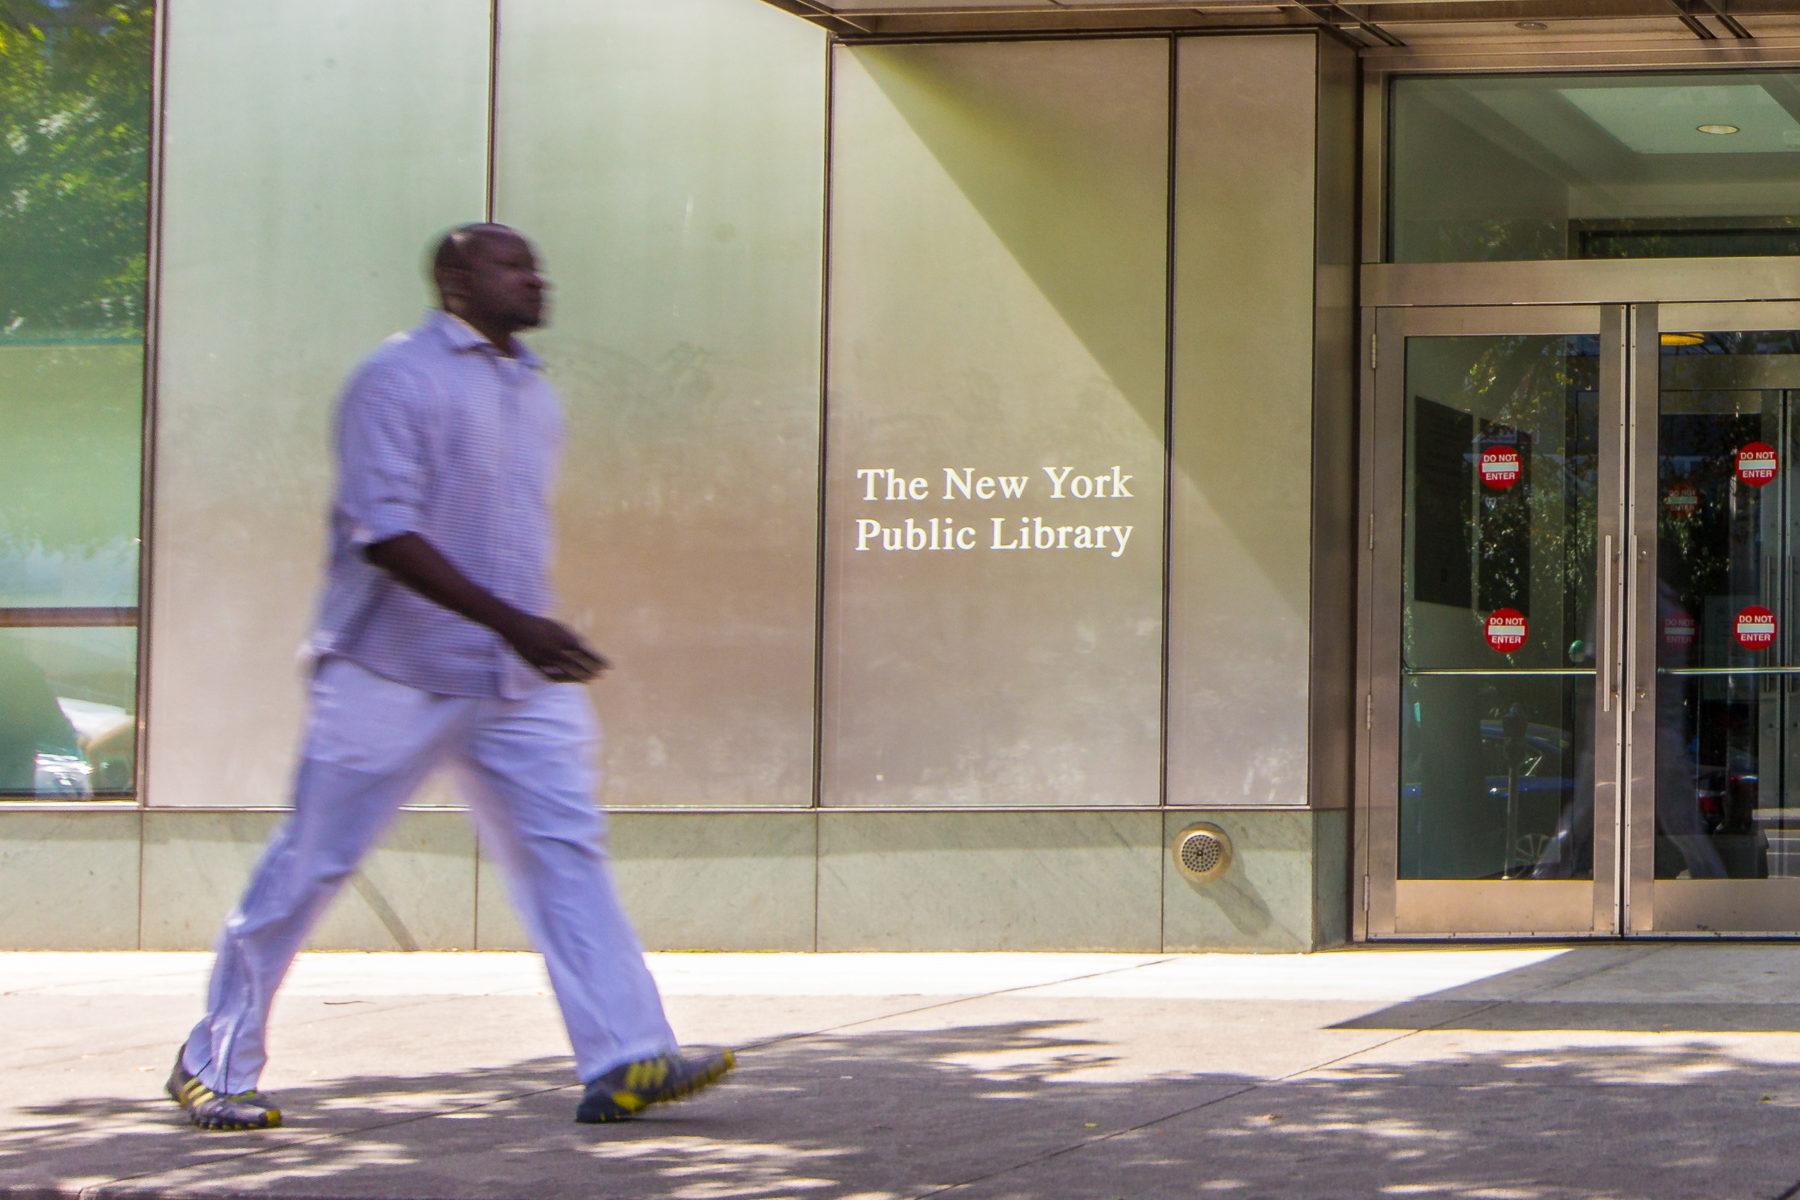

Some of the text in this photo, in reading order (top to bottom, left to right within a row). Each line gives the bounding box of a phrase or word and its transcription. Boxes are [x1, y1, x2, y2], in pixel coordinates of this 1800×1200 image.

[1483, 453, 1517, 462] DO NOT
[1755, 451, 1774, 459] NOT
[1486, 472, 1515, 480] ENTER
[1742, 470, 1772, 478] ENTER
[857, 465, 1134, 501] The New York
[855, 517, 1134, 558] Public Library
[1490, 617, 1524, 625] DO NOT
[1739, 615, 1773, 623] DO NOT
[1491, 635, 1521, 644] ENTER
[1741, 633, 1770, 642] ENTER
